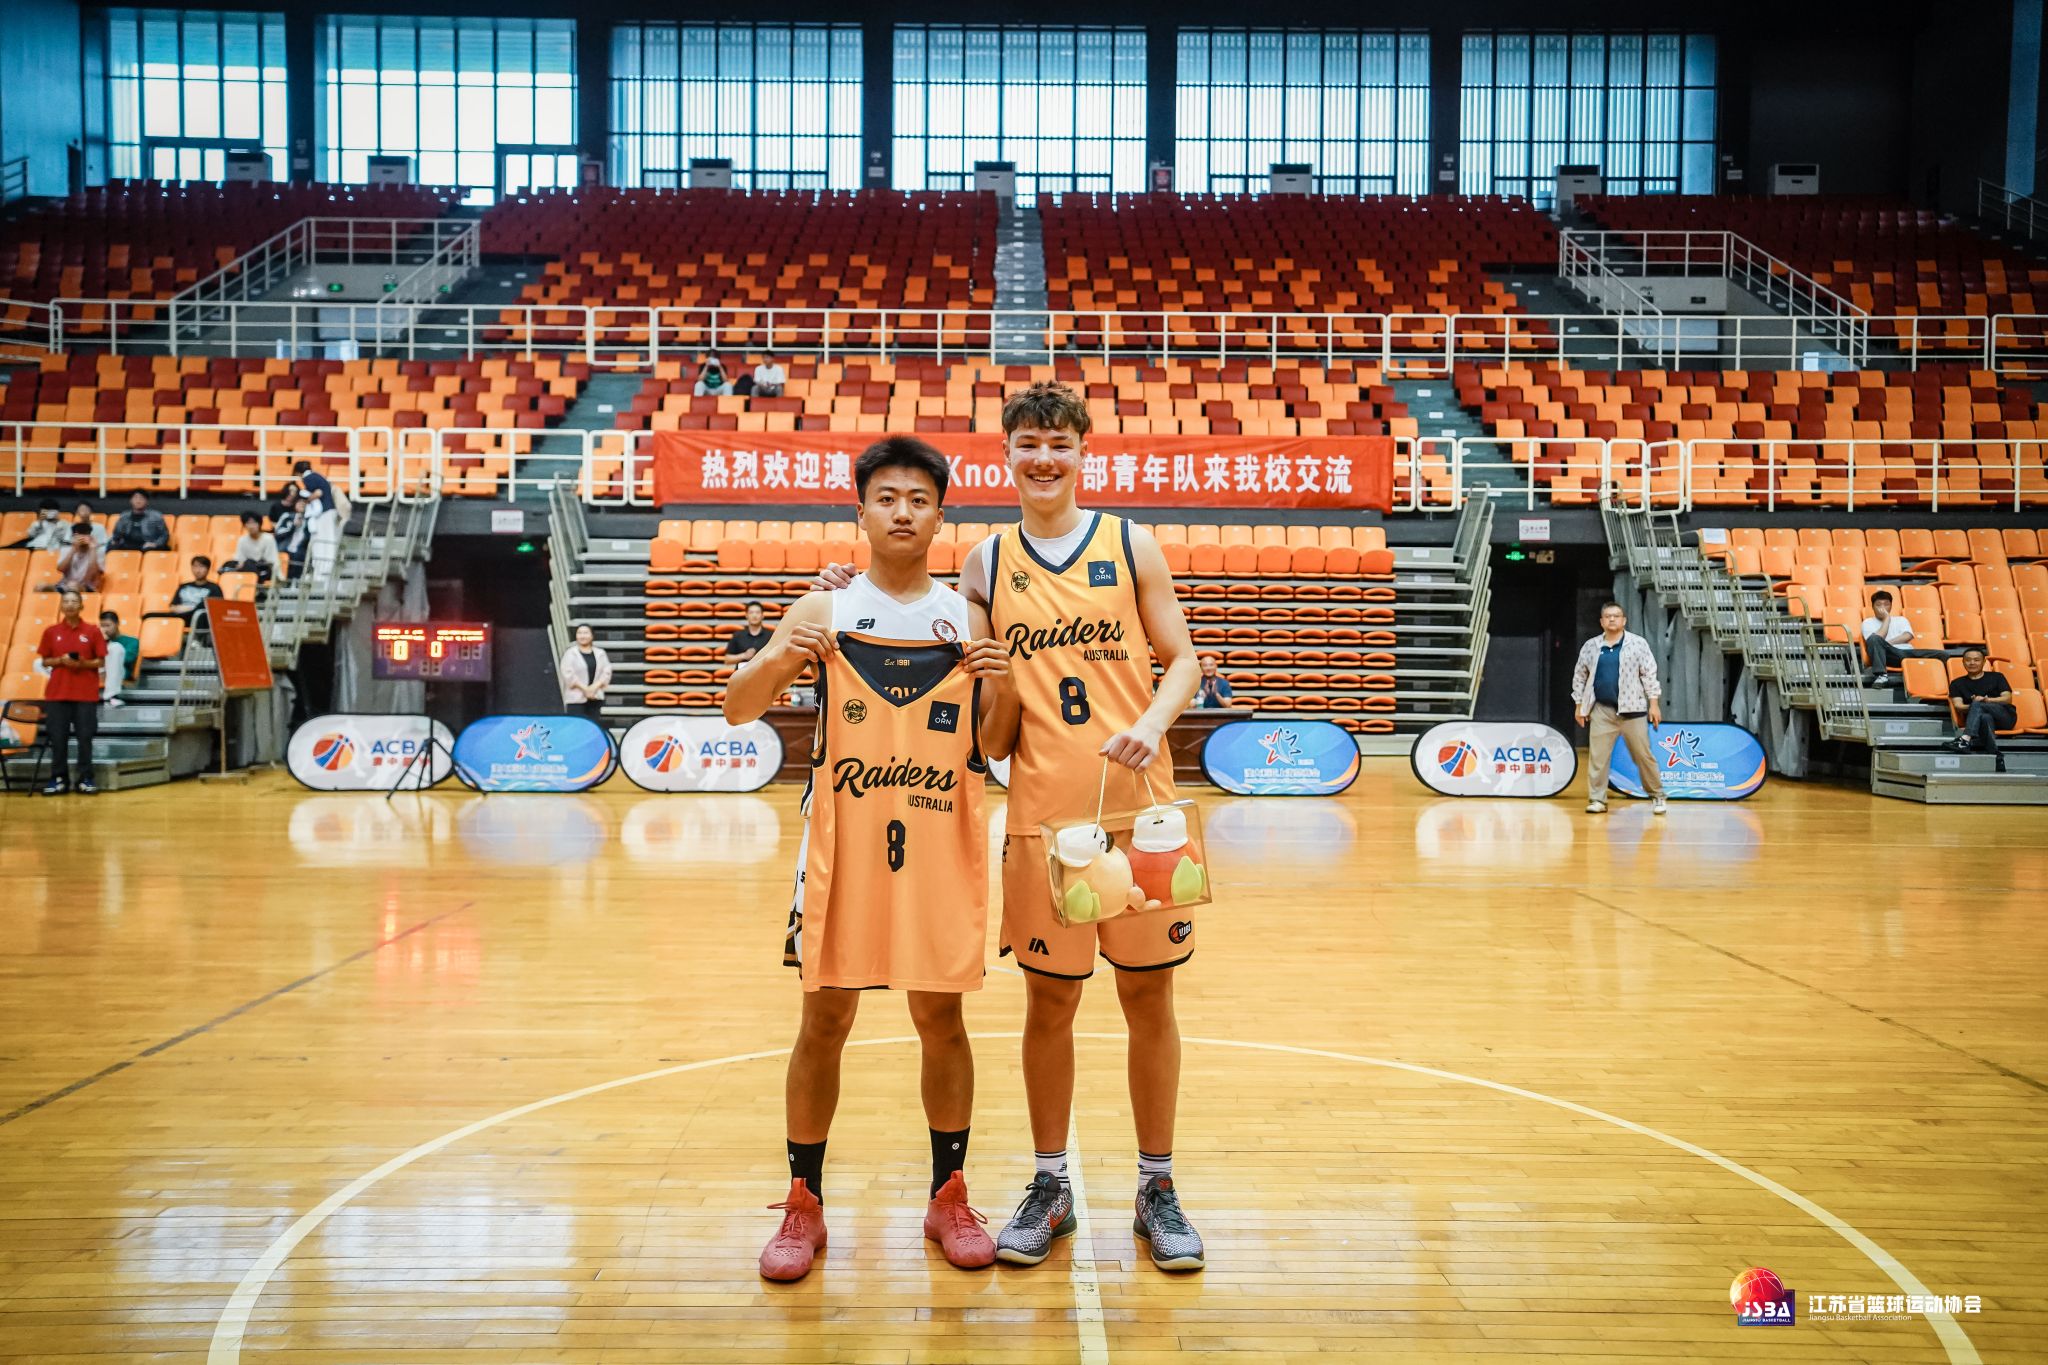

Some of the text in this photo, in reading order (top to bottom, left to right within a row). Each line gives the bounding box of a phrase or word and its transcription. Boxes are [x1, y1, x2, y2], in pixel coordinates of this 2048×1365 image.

[702, 449, 851, 489] 热烈欢迎澳
[1081, 453, 1353, 494] 部青年队来我校交流
[1005, 616, 1125, 661] Raiders
[1083, 649, 1130, 661] AUSTRALIA
[934, 717, 952, 726] ORN
[1058, 676, 1091, 726] 8
[700, 741, 758, 756] ACBA
[1493, 747, 1552, 762] ACBA
[833, 756, 958, 799] Raiders
[886, 819, 906, 872] 8
